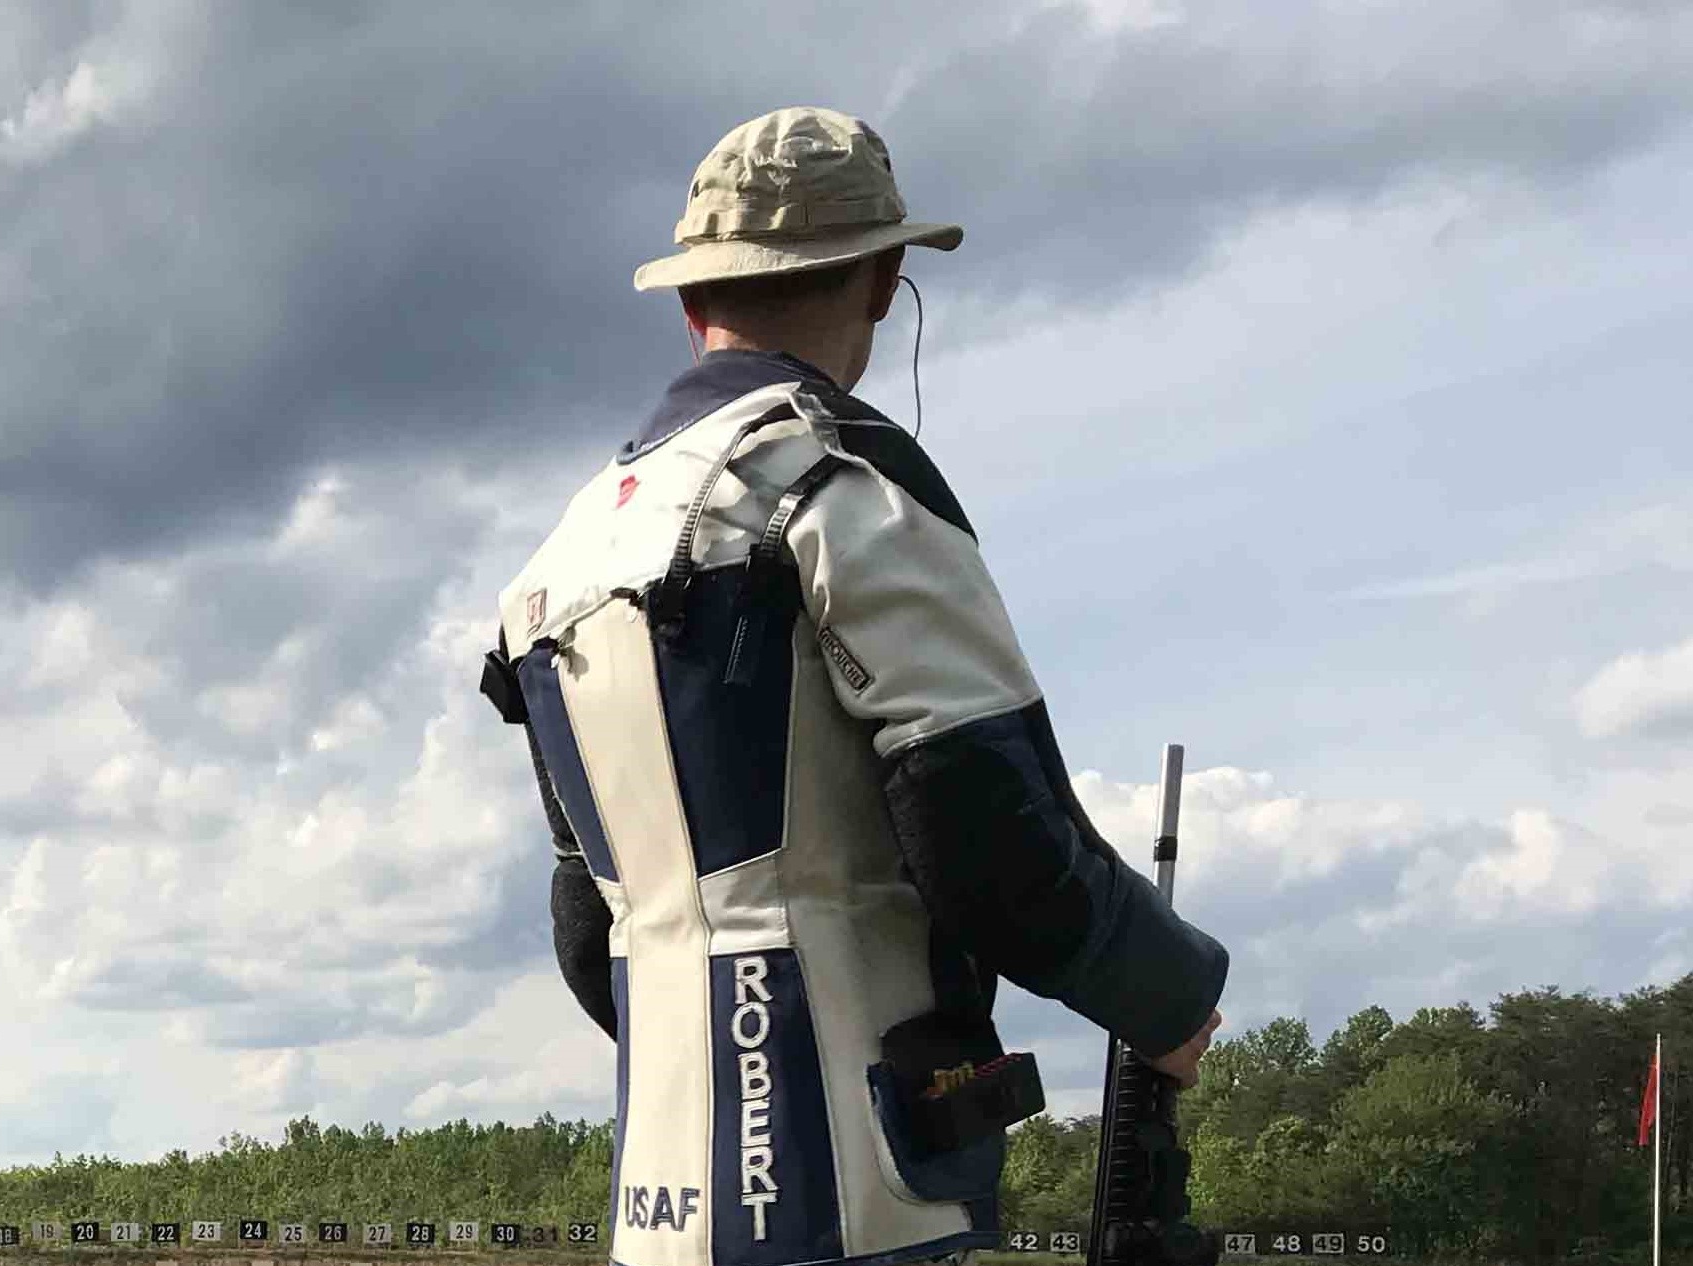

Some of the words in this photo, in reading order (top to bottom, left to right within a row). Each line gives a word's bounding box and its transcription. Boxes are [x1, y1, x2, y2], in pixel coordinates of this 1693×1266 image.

[731, 955, 779, 1240] ROBERT
[624, 1185, 700, 1231] USAF
[39, 1223, 54, 1239] 19
[76, 1224, 94, 1240] 20
[116, 1225, 131, 1240] 21
[158, 1225, 174, 1241] 22
[198, 1223, 214, 1239] 23
[244, 1222, 262, 1238] 24
[285, 1226, 302, 1241] 25
[325, 1225, 342, 1240] 26
[369, 1226, 385, 1241] 27
[412, 1225, 429, 1241] 28
[456, 1224, 473, 1239] 29
[496, 1226, 514, 1242] 30
[532, 1226, 557, 1243] 31
[569, 1224, 596, 1241] 32
[1010, 1233, 1039, 1250] 42
[1052, 1234, 1079, 1251] 43
[1227, 1235, 1253, 1252] 47
[1273, 1235, 1301, 1252] 48
[1314, 1235, 1342, 1252] 49
[1357, 1235, 1386, 1252] 50
